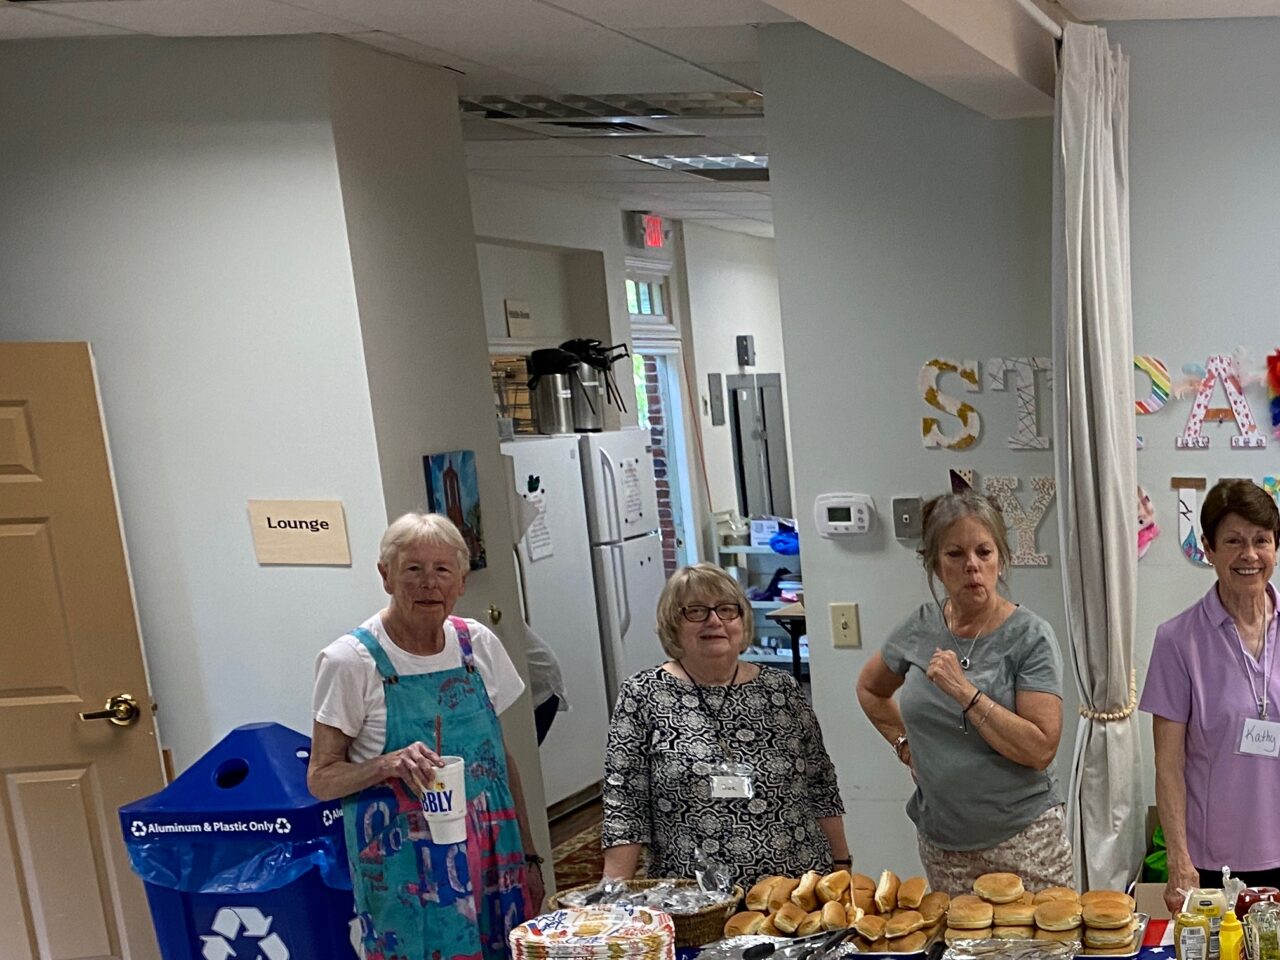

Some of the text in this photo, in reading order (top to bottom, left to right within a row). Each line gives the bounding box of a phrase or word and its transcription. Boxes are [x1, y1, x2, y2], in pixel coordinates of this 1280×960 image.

[266, 516, 329, 532] Lounge
[1245, 725, 1276, 752] Kathy
[148, 820, 274, 834] Aluminum & Plastic Only
